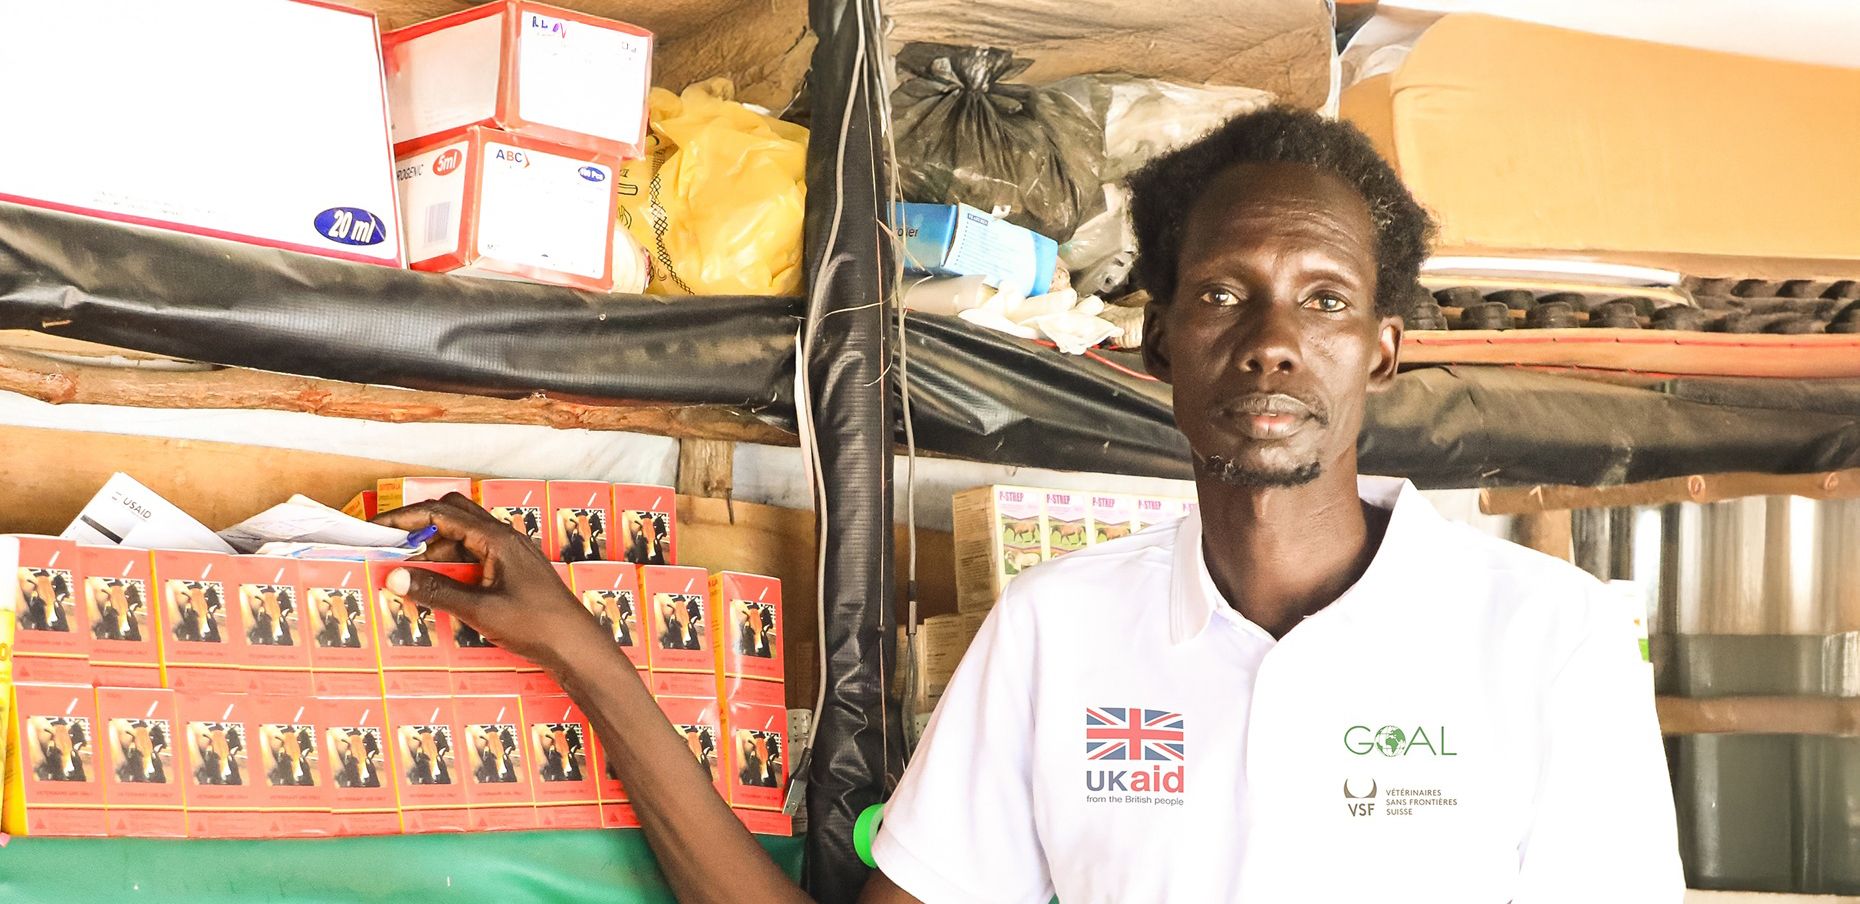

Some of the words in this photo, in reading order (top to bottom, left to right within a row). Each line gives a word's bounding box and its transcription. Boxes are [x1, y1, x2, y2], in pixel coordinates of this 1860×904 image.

[437, 151, 457, 172] 5ml
[496, 149, 523, 163] ABC
[328, 209, 353, 239] 20
[350, 217, 376, 244] ml
[999, 490, 1024, 502] P-STREP
[1046, 493, 1071, 506] P-STREP
[1092, 496, 1116, 508] P-STREP
[123, 497, 152, 519] USAID
[1138, 499, 1162, 511] P-STREP
[1344, 725, 1458, 757] GOAL
[1385, 788, 1442, 796] VÉTÉRINAIRES
[1086, 795, 1107, 803] from
[1109, 795, 1123, 803] the
[1125, 795, 1152, 804] British
[1154, 797, 1184, 807] people
[1385, 798, 1407, 806] SANS
[1347, 803, 1376, 817] VSF
[1386, 808, 1413, 816] SUISSE
